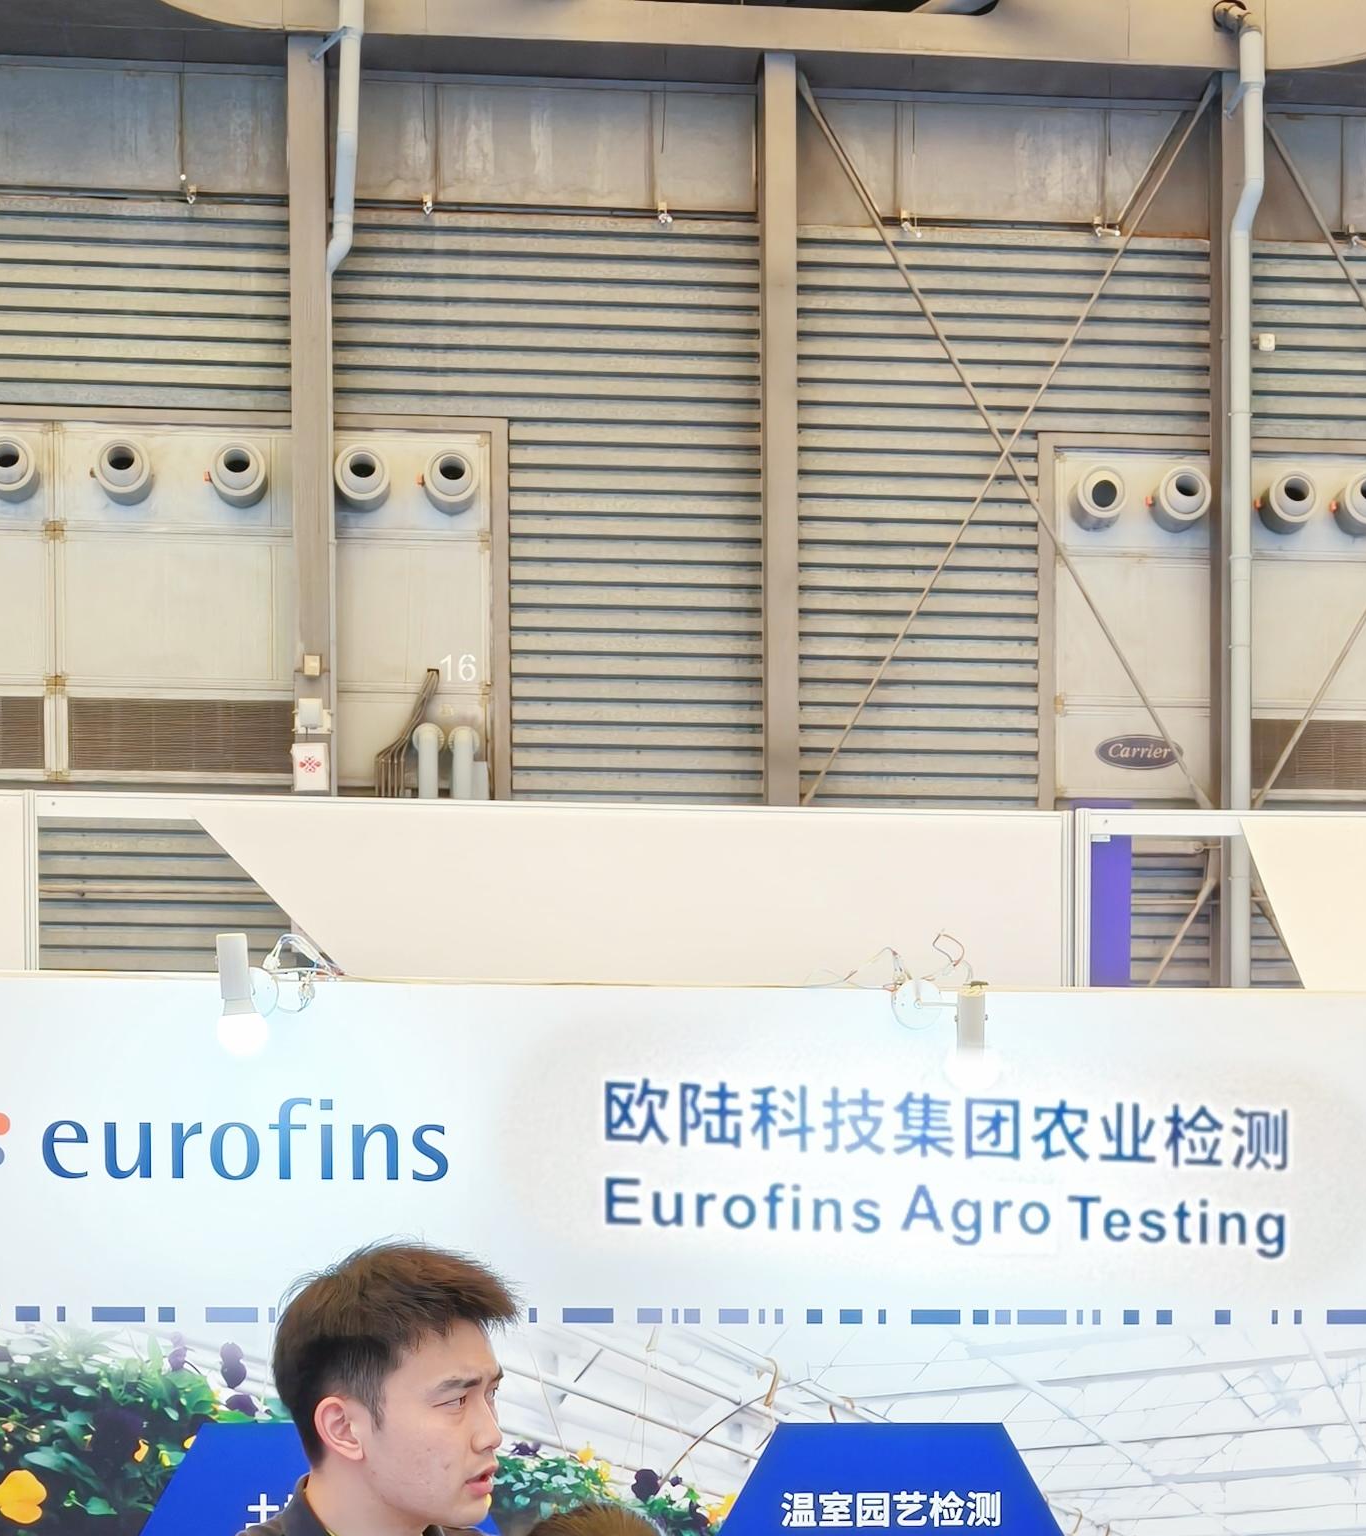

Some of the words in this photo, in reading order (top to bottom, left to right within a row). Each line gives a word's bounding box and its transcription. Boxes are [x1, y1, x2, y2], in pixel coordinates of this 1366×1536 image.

[439, 653, 477, 682] 16
[1107, 742, 1172, 759] Carrier
[41, 1097, 450, 1183] eurofins
[603, 1079, 1291, 1172] 欧陆科技集团农业检测
[603, 1176, 882, 1235] Eurofins
[901, 1184, 1053, 1245] Agro
[1067, 1194, 1288, 1259] Testing
[245, 1493, 294, 1529] 土
[780, 1490, 1003, 1529] 温室园艺检测
